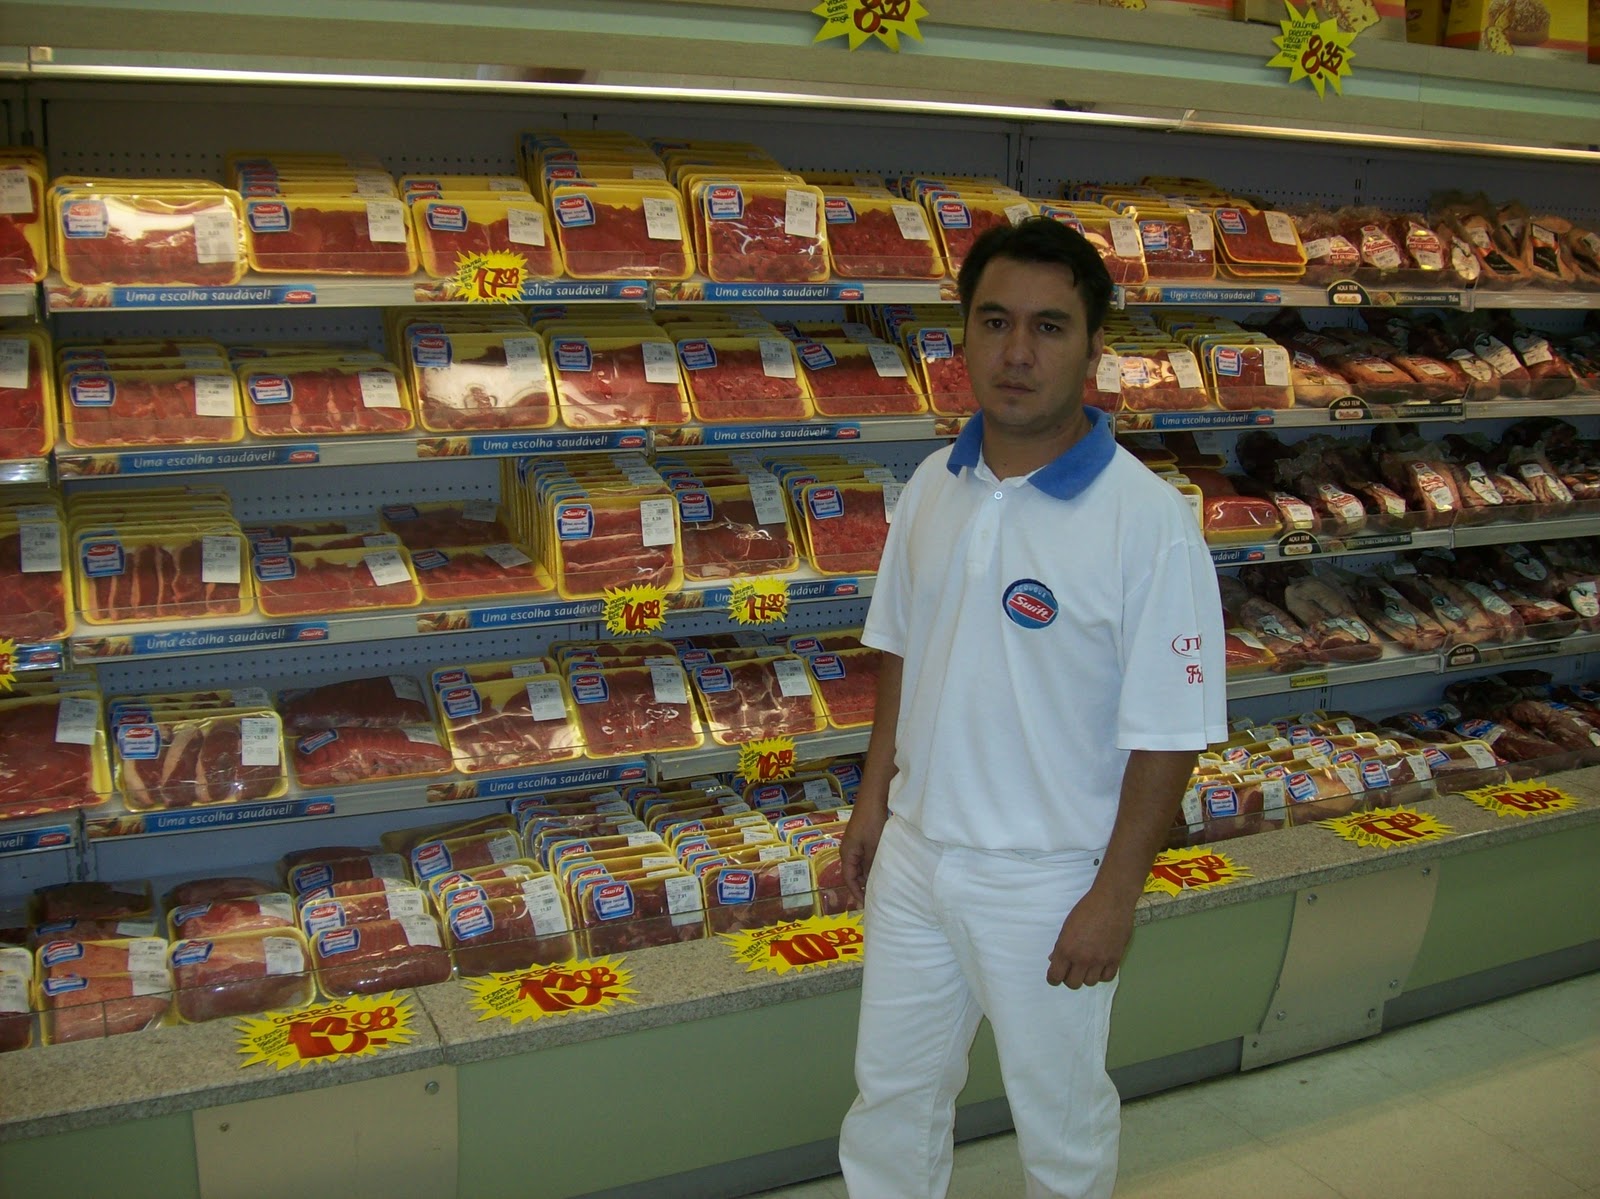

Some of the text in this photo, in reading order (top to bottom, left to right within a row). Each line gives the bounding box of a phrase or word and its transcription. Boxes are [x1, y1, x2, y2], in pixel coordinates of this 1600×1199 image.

[713, 188, 736, 198] Swift
[560, 198, 584, 208] Swift
[826, 200, 845, 208] Swift
[942, 204, 963, 212] Swift
[126, 288, 271, 302] Uma escolha saudável!
[556, 284, 608, 296] saudável!
[715, 286, 829, 297] Uma escolha saudável!
[1190, 291, 1217, 299] escolha
[1220, 291, 1255, 300] saudável!
[924, 332, 944, 340] Swift
[561, 343, 584, 352] Swift
[685, 343, 706, 352] Swift
[256, 378, 281, 387] Swift
[1162, 414, 1248, 425] Uma escolha saudável!
[714, 431, 737, 441] Uma
[740, 428, 777, 439] escolha
[483, 436, 608, 451] Uma escolha saudável!
[134, 452, 276, 469] Uma escolha saudável!
[682, 494, 704, 502] Swift
[814, 490, 835, 499] Swift
[562, 508, 586, 517] Swift
[715, 592, 731, 602] Um
[786, 584, 825, 597] audável!
[1010, 596, 1050, 620] Swift
[482, 612, 510, 624] Uma
[513, 607, 551, 620] escolha
[147, 630, 285, 650] Uma escolha saudável!
[815, 655, 835, 664] Swift
[701, 667, 724, 676] Swift
[577, 675, 599, 685] Swift
[447, 688, 471, 699] Swift
[490, 770, 609, 793] Uma escolha saudável!
[760, 789, 781, 799] Swift
[1213, 790, 1230, 798] Swift
[158, 805, 293, 828] Uma escolha saudável!
[784, 819, 805, 829] Swift
[810, 842, 830, 854] Swift
[727, 873, 750, 883] Swift
[601, 884, 625, 896] Swift
[458, 905, 483, 920] Swift
[273, 1005, 347, 1025] OFERTA
